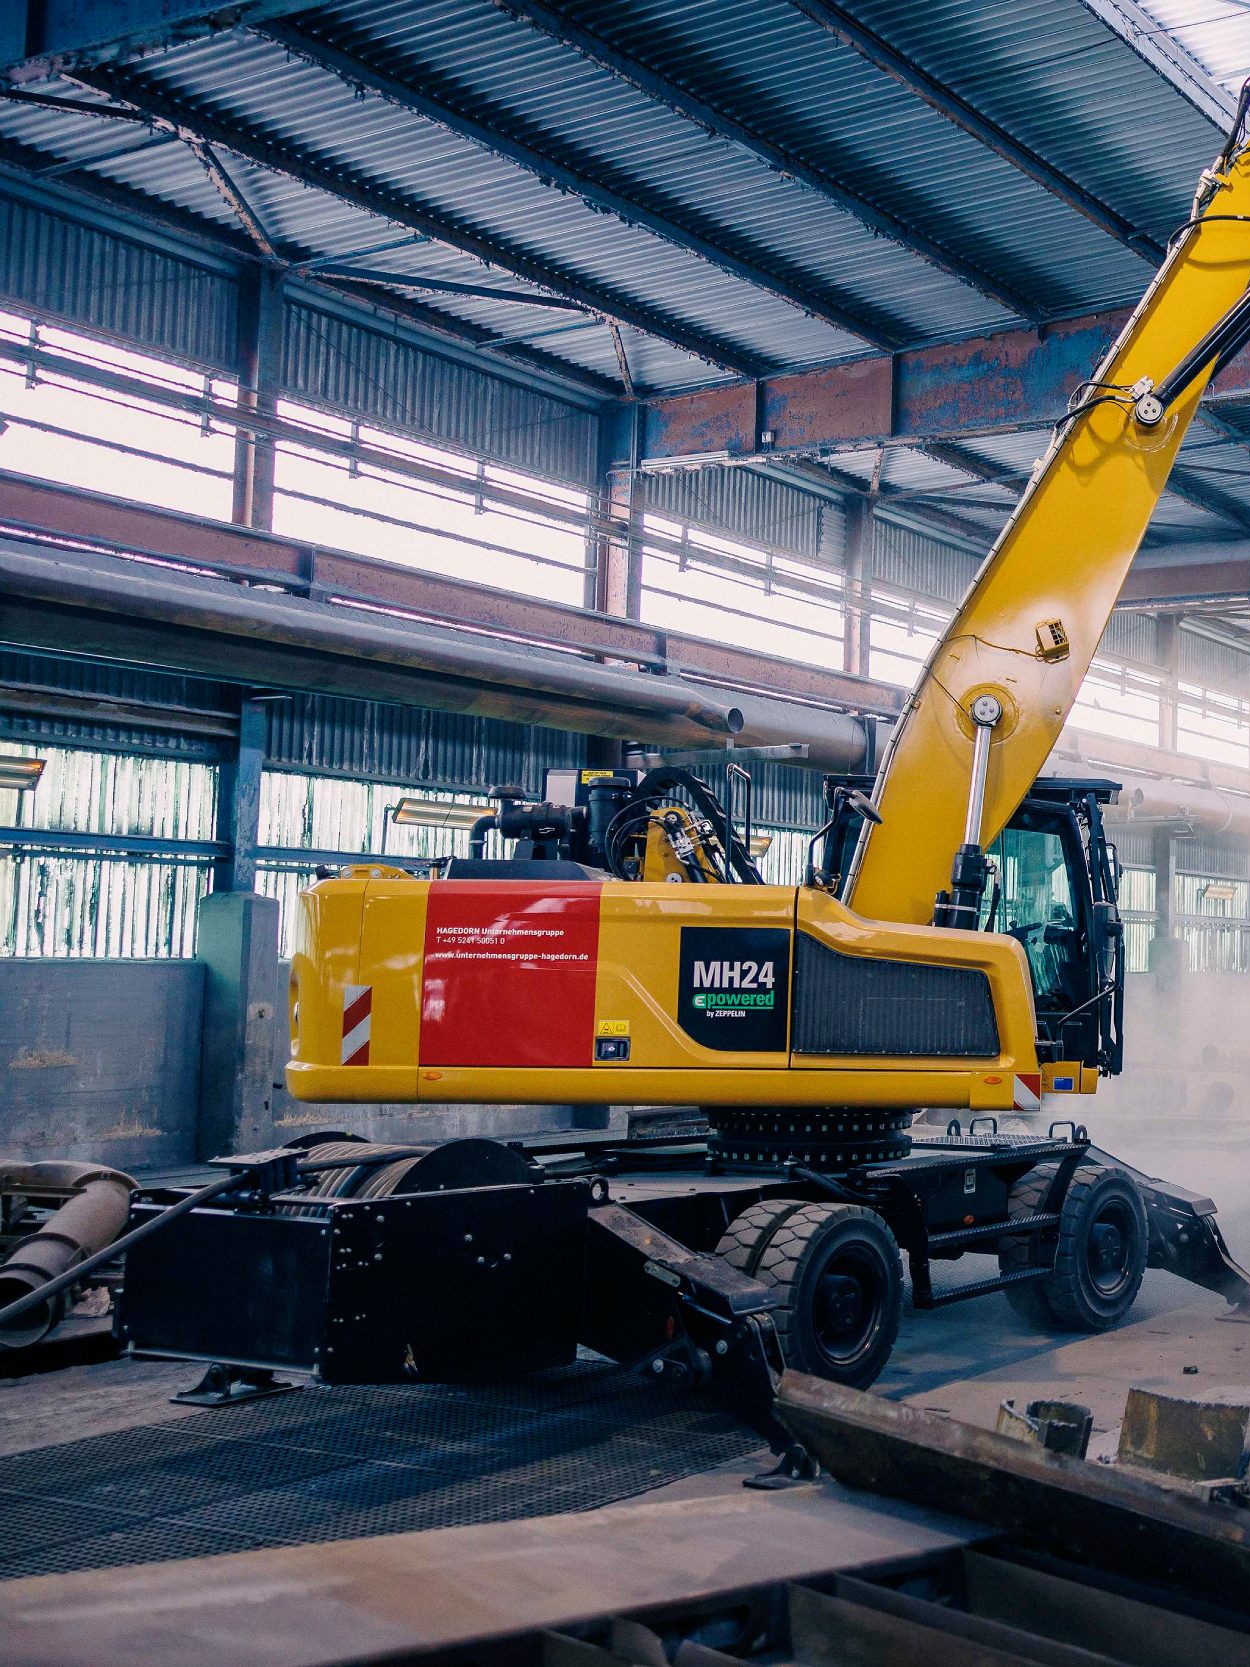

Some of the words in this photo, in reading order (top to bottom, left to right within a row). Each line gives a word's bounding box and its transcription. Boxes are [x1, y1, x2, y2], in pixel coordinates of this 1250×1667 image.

[481, 927, 565, 937] Unternehmensgruppe
[435, 952, 589, 961] www.unternehmensgruppe-hagedorn.de
[693, 961, 775, 989] MH24
[706, 1010, 715, 1018] by
[715, 1010, 746, 1018] ZEPPELIN
